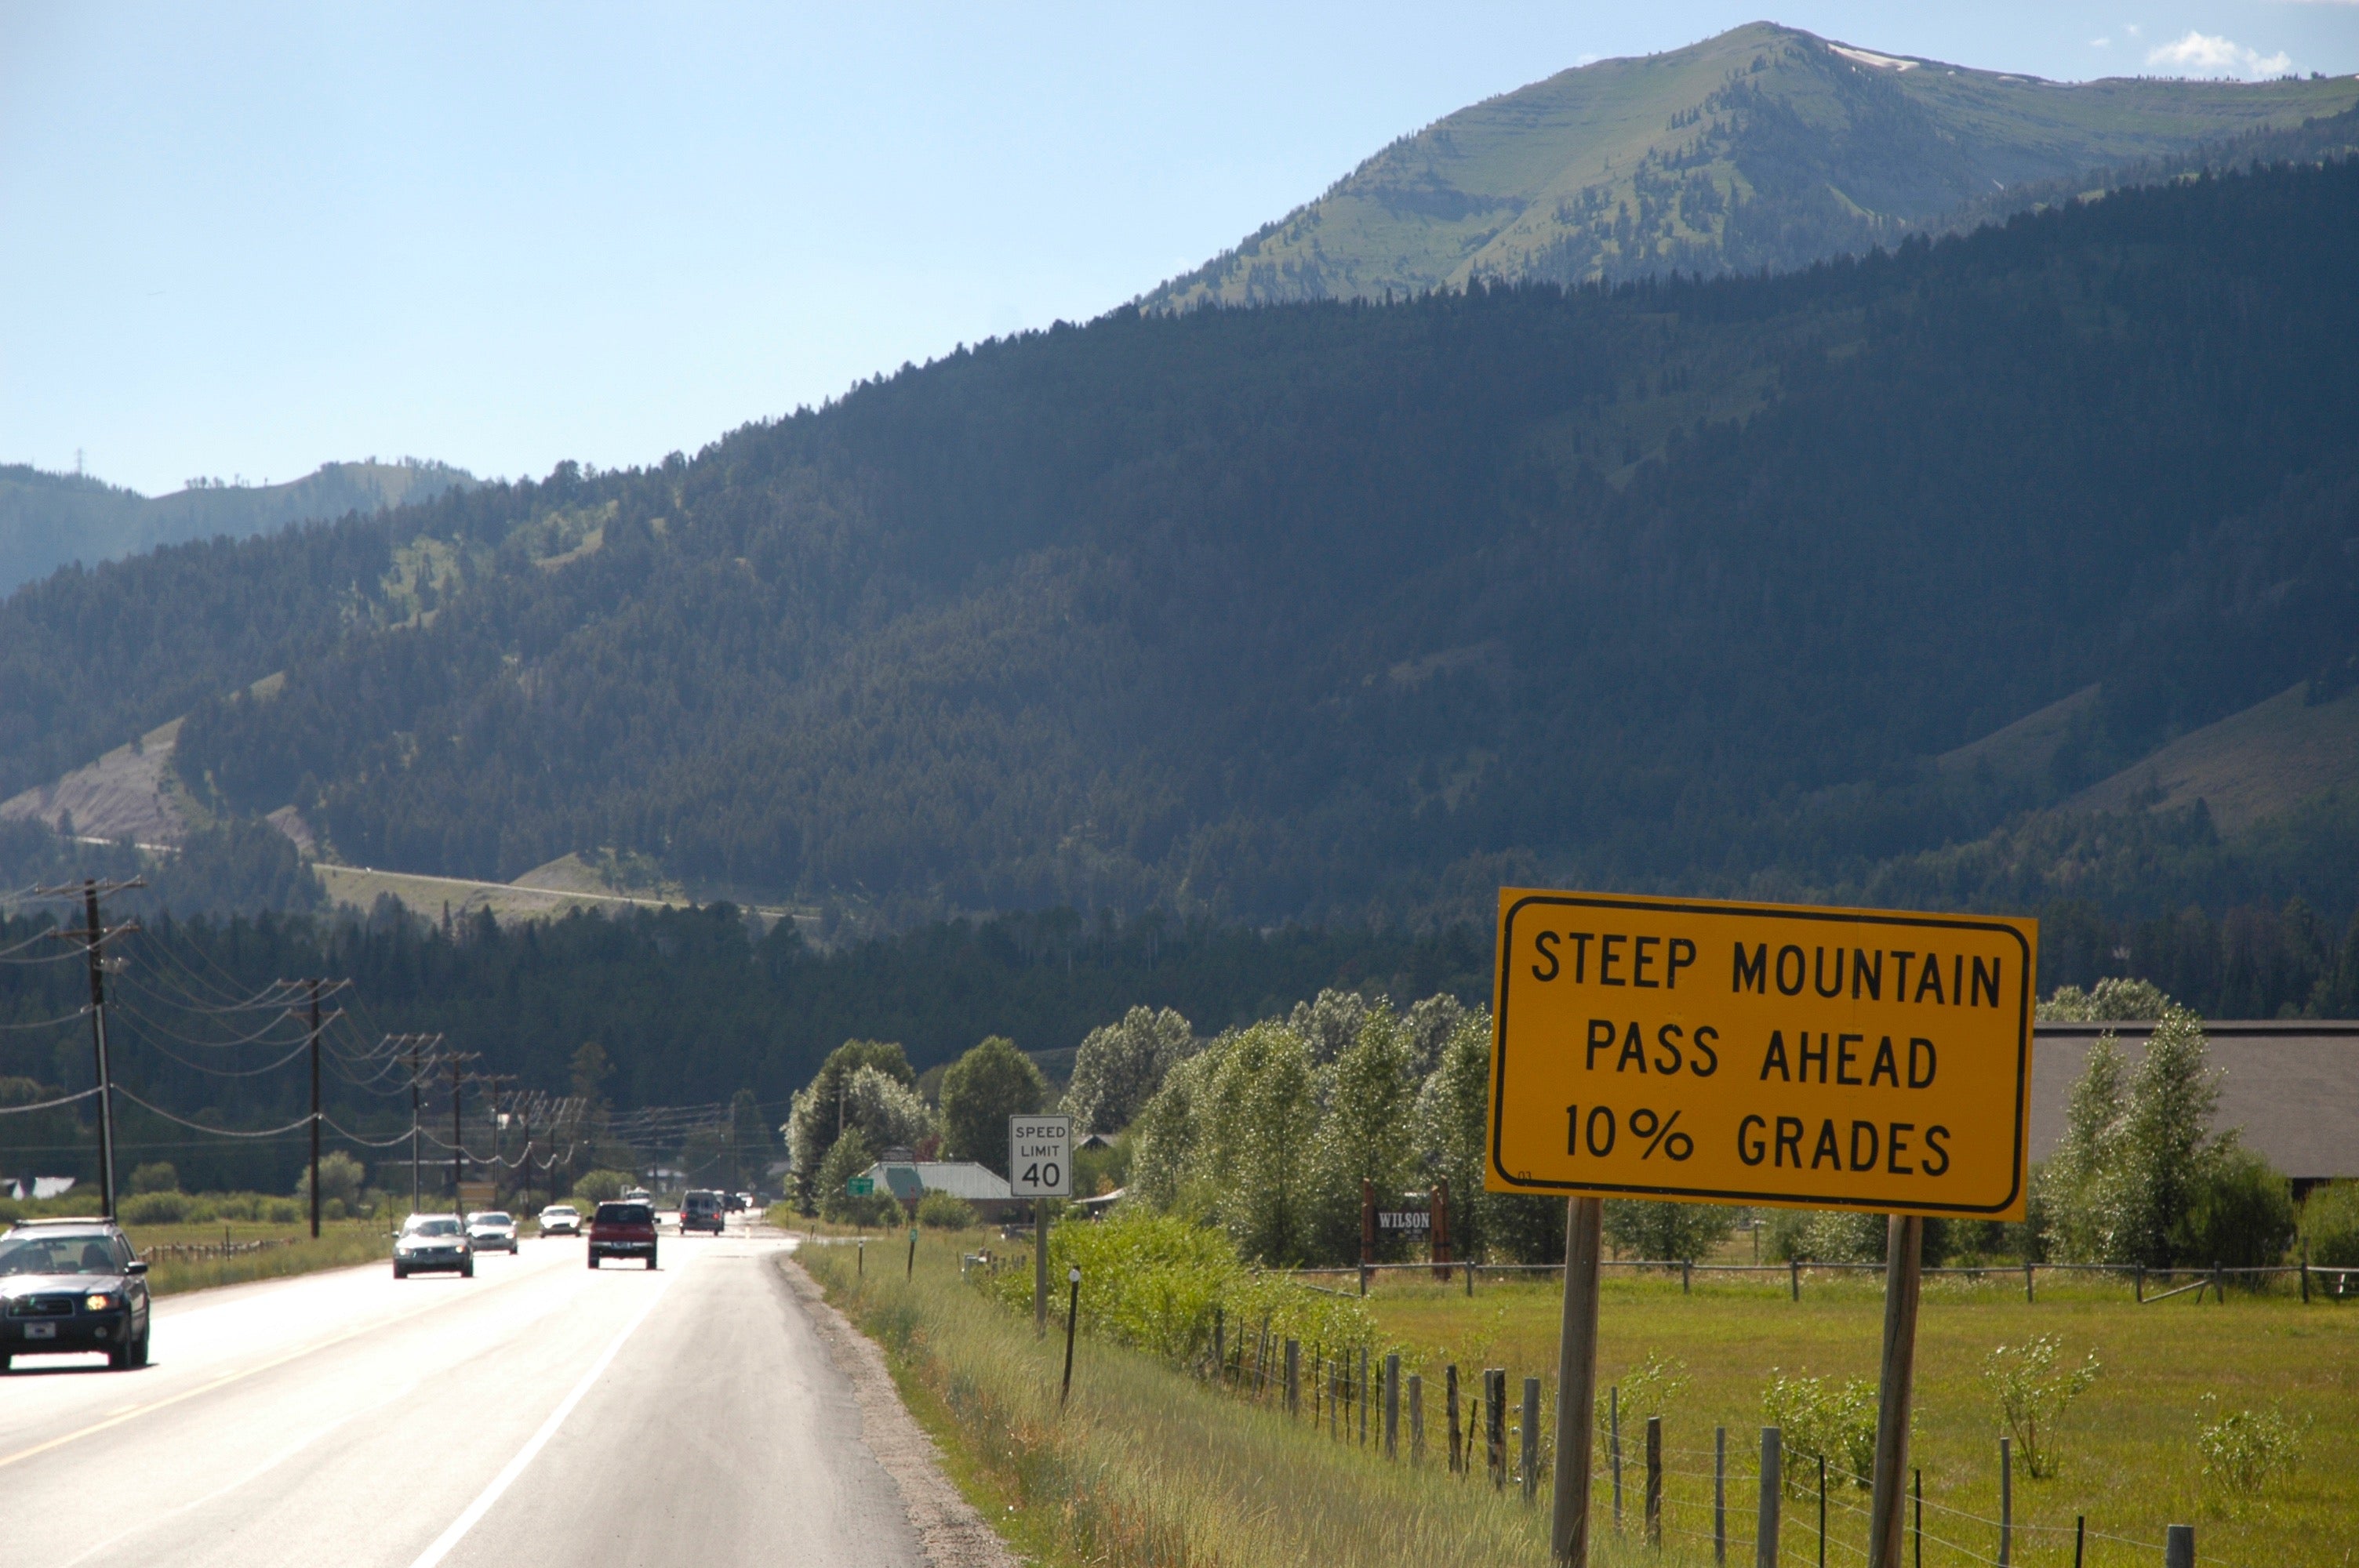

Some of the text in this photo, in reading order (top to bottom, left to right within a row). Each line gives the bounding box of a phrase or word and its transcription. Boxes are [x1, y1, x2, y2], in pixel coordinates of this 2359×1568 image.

[1532, 931, 2001, 1008] STEEP MOUNTAIN
[1585, 1019, 1937, 1090] PASS AHEAD
[1016, 1127, 1066, 1138] SPEED
[1566, 1105, 1951, 1177] 10% GRADES
[1021, 1145, 1060, 1157] LIMIT
[1022, 1163, 1060, 1188] 40
[1379, 1212, 1430, 1229] WILSON
